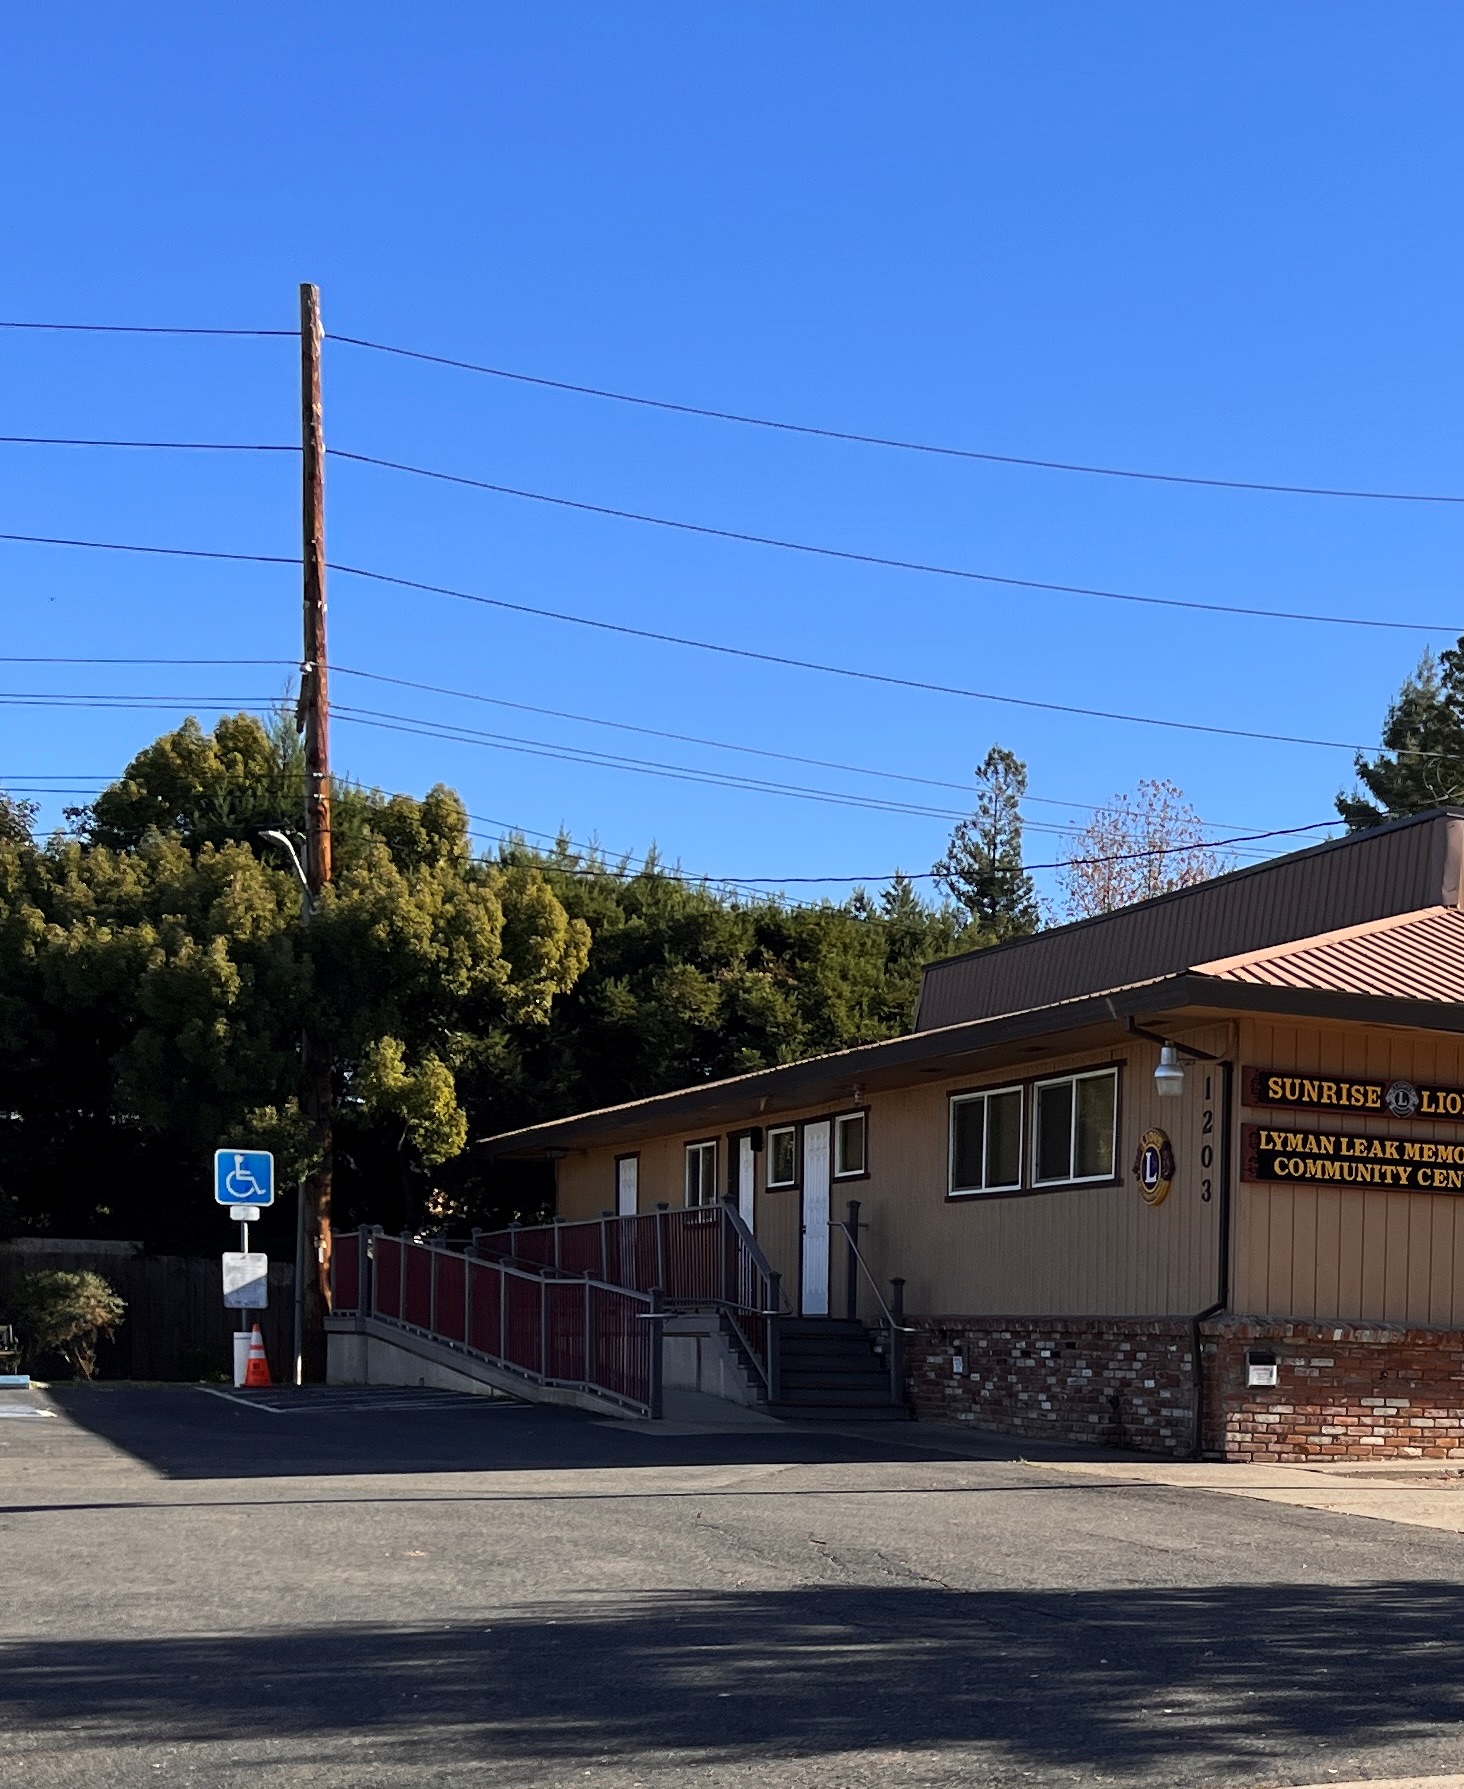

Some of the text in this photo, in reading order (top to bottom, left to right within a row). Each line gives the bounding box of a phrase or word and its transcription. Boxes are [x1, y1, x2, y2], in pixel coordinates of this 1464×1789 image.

[1268, 1077, 1381, 1108] SUNRISE
[1397, 1091, 1408, 1106] L
[1201, 1076, 1213, 1202] 1203
[1259, 1131, 1335, 1154] LYMAN
[1340, 1137, 1400, 1159] LEAK
[1145, 1152, 1157, 1183] L
[1274, 1157, 1412, 1185] COMMUNITY
